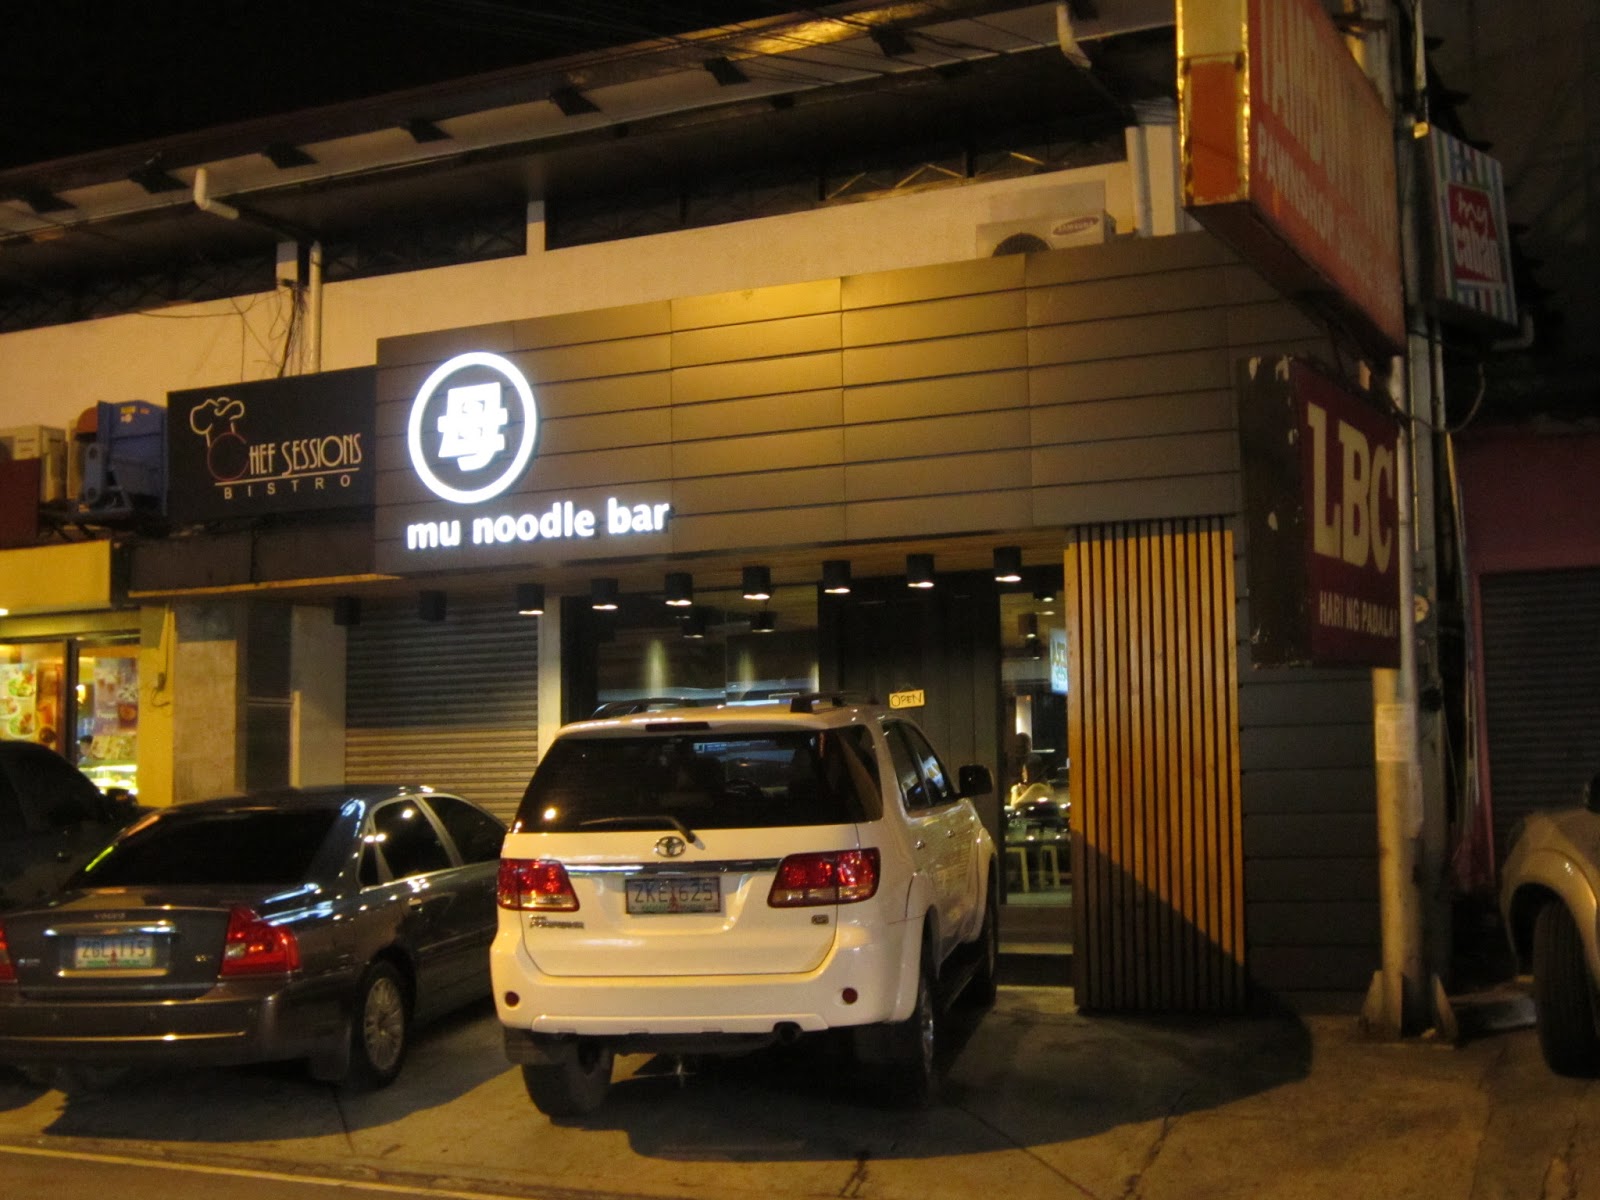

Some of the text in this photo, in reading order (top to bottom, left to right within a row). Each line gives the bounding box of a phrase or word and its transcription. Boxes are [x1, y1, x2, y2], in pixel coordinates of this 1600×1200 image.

[1257, 121, 1334, 246] PAWNSHOP
[281, 433, 363, 477] SESSIONS
[224, 474, 351, 499] BISTRO
[1307, 402, 1393, 574] LBC
[407, 498, 670, 549] mu noodle bar
[1319, 590, 1344, 627] HARI
[1346, 596, 1360, 632] NG
[890, 692, 922, 707] OPEN
